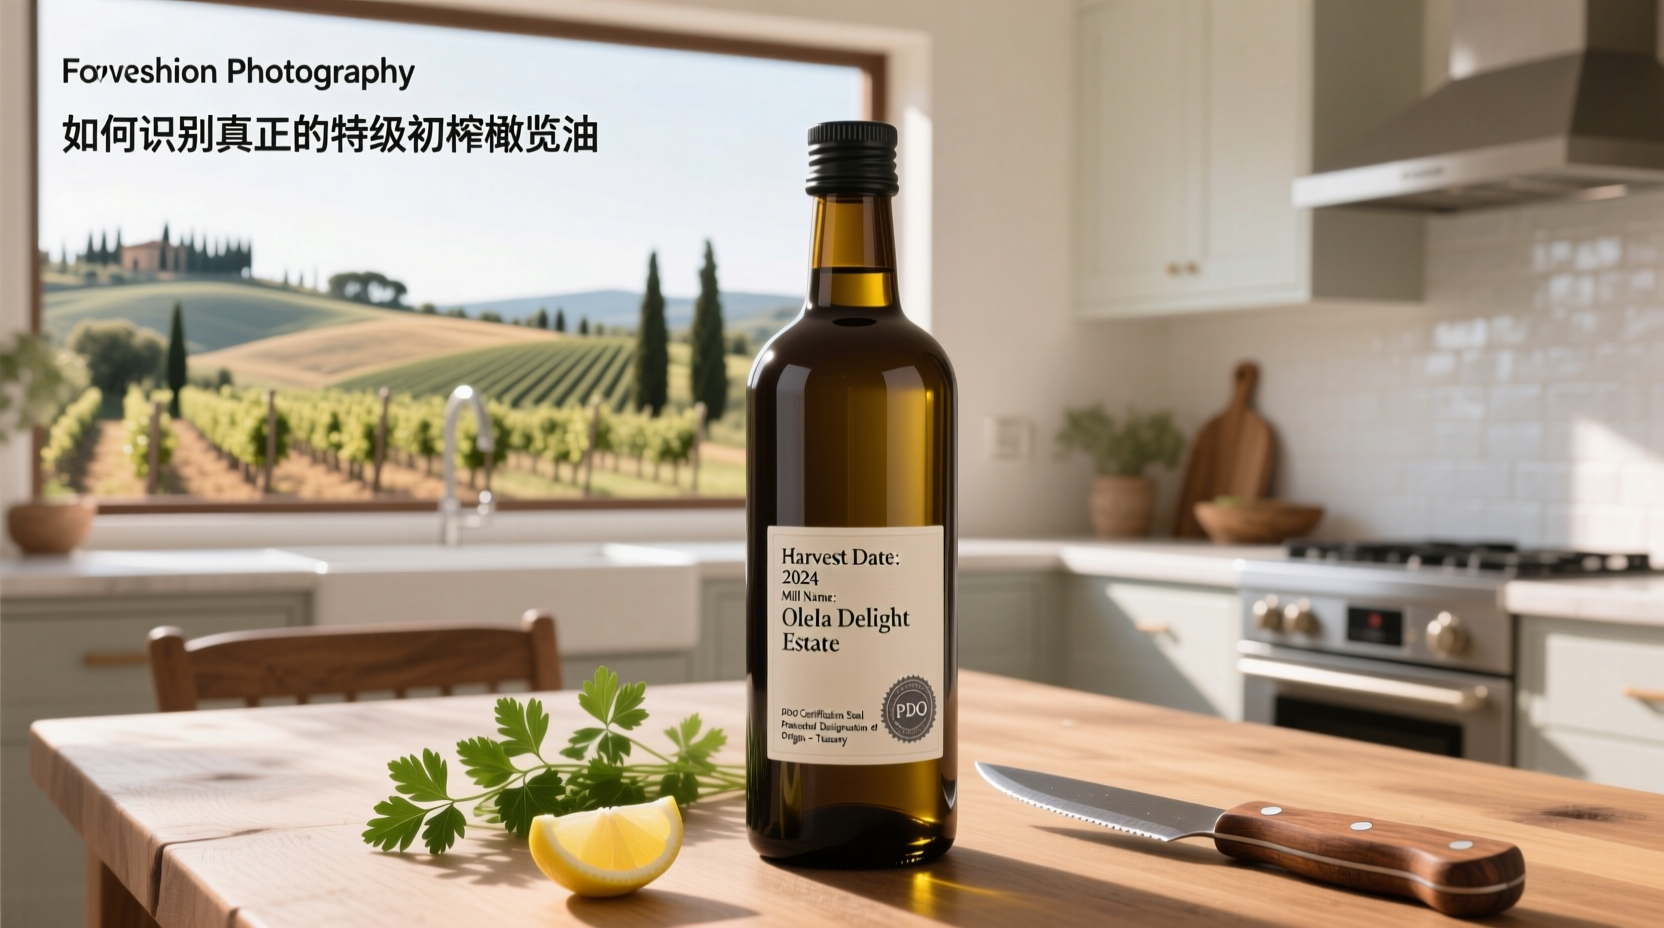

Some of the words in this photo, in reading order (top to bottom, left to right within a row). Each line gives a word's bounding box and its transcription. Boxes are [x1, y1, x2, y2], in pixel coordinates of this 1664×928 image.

[782, 547, 848, 566] Harvest
[852, 548, 901, 566] Date:
[782, 570, 819, 586] 2024
[781, 590, 801, 602] Mill
[782, 607, 832, 628] Olela
[837, 607, 911, 634] Delight
[782, 632, 840, 652] Estate
[896, 701, 928, 719] PDO
